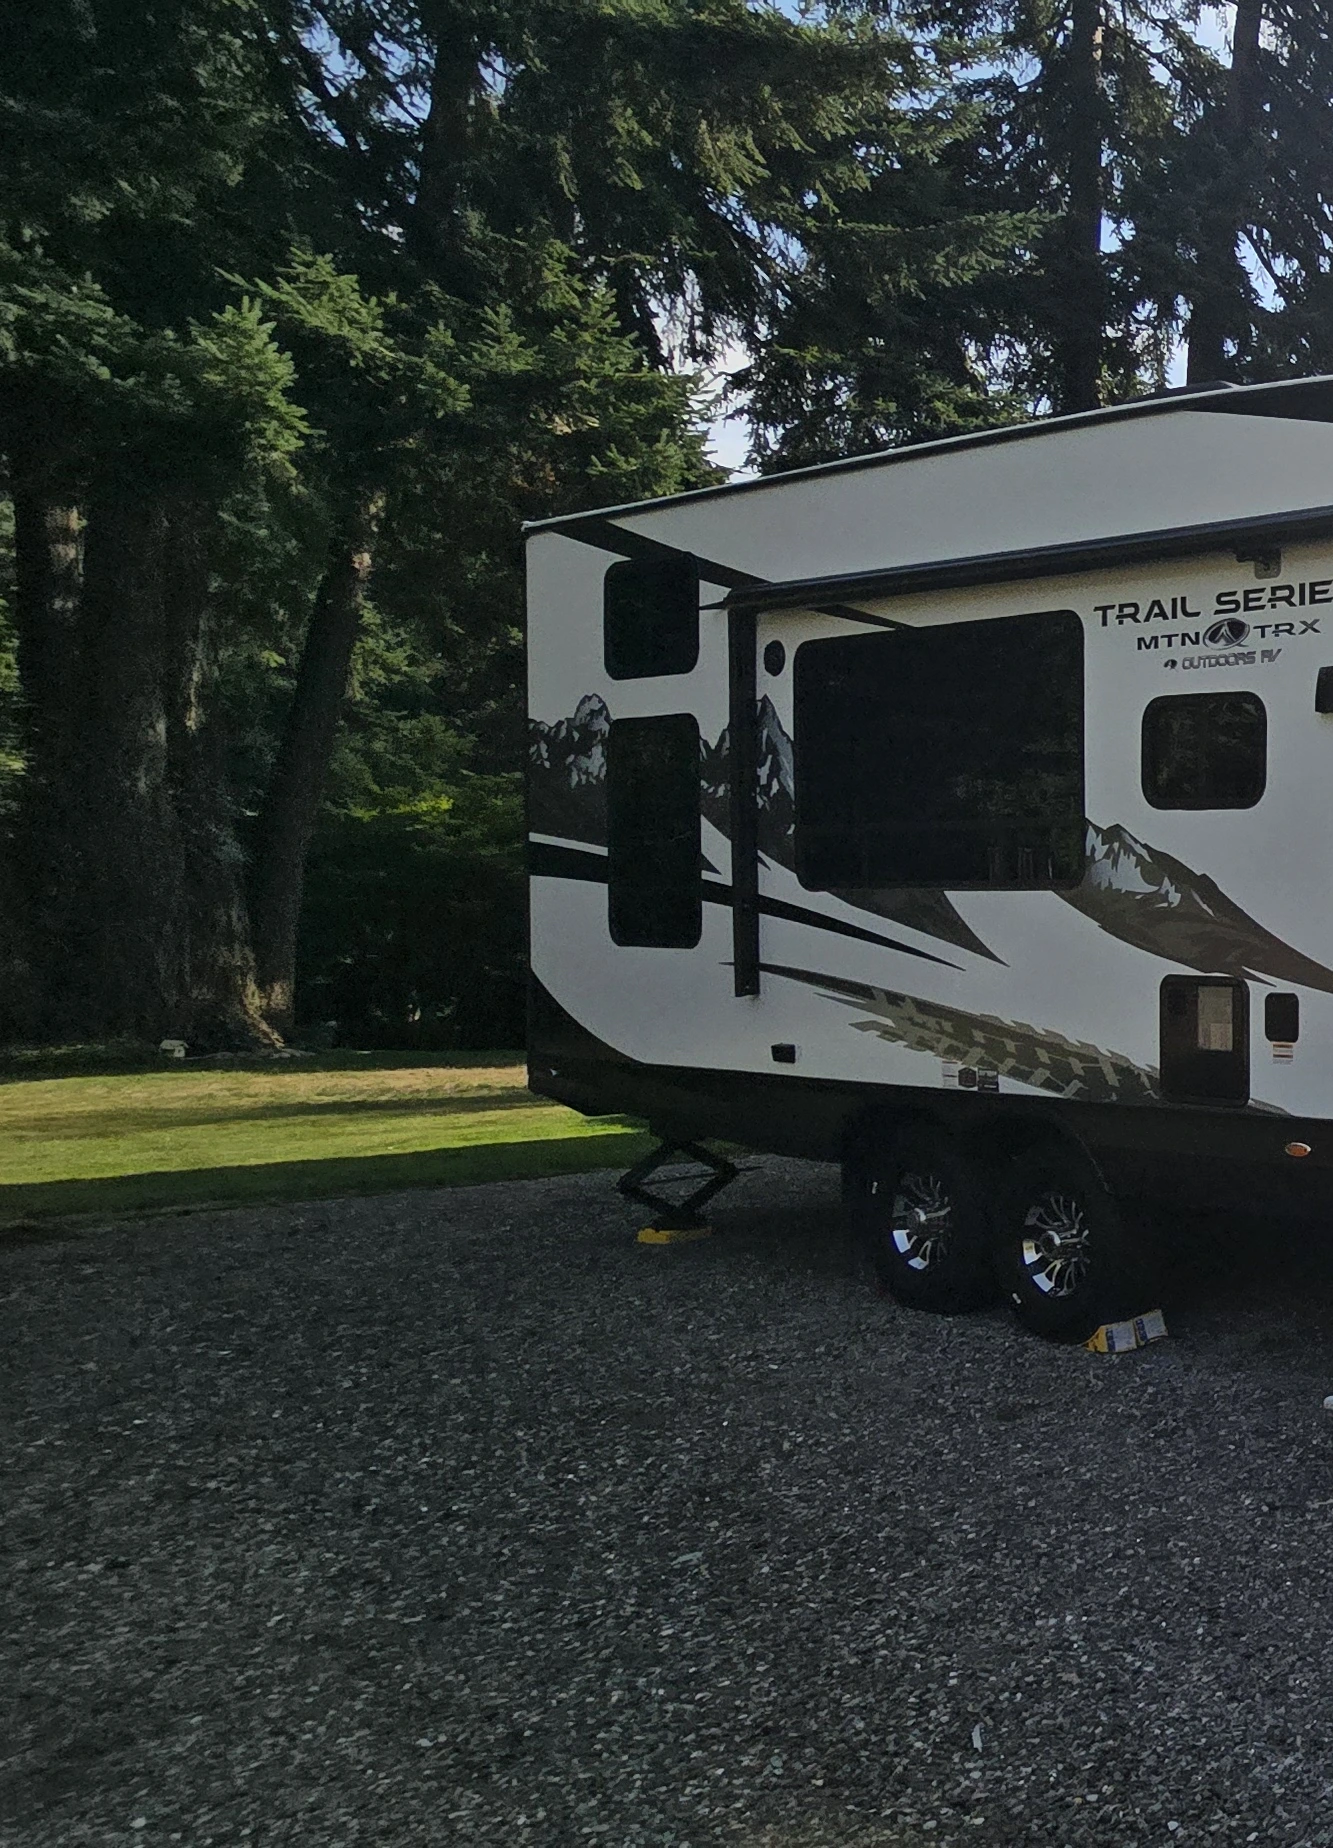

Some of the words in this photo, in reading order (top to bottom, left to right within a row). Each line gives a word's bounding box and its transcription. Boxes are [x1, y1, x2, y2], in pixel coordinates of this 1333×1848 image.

[1093, 596, 1201, 627] TRAIL
[1137, 631, 1200, 651] MTN
[1252, 618, 1322, 639] TRX
[1181, 650, 1257, 670] OUTDOORS
[1260, 648, 1283, 664] RV
